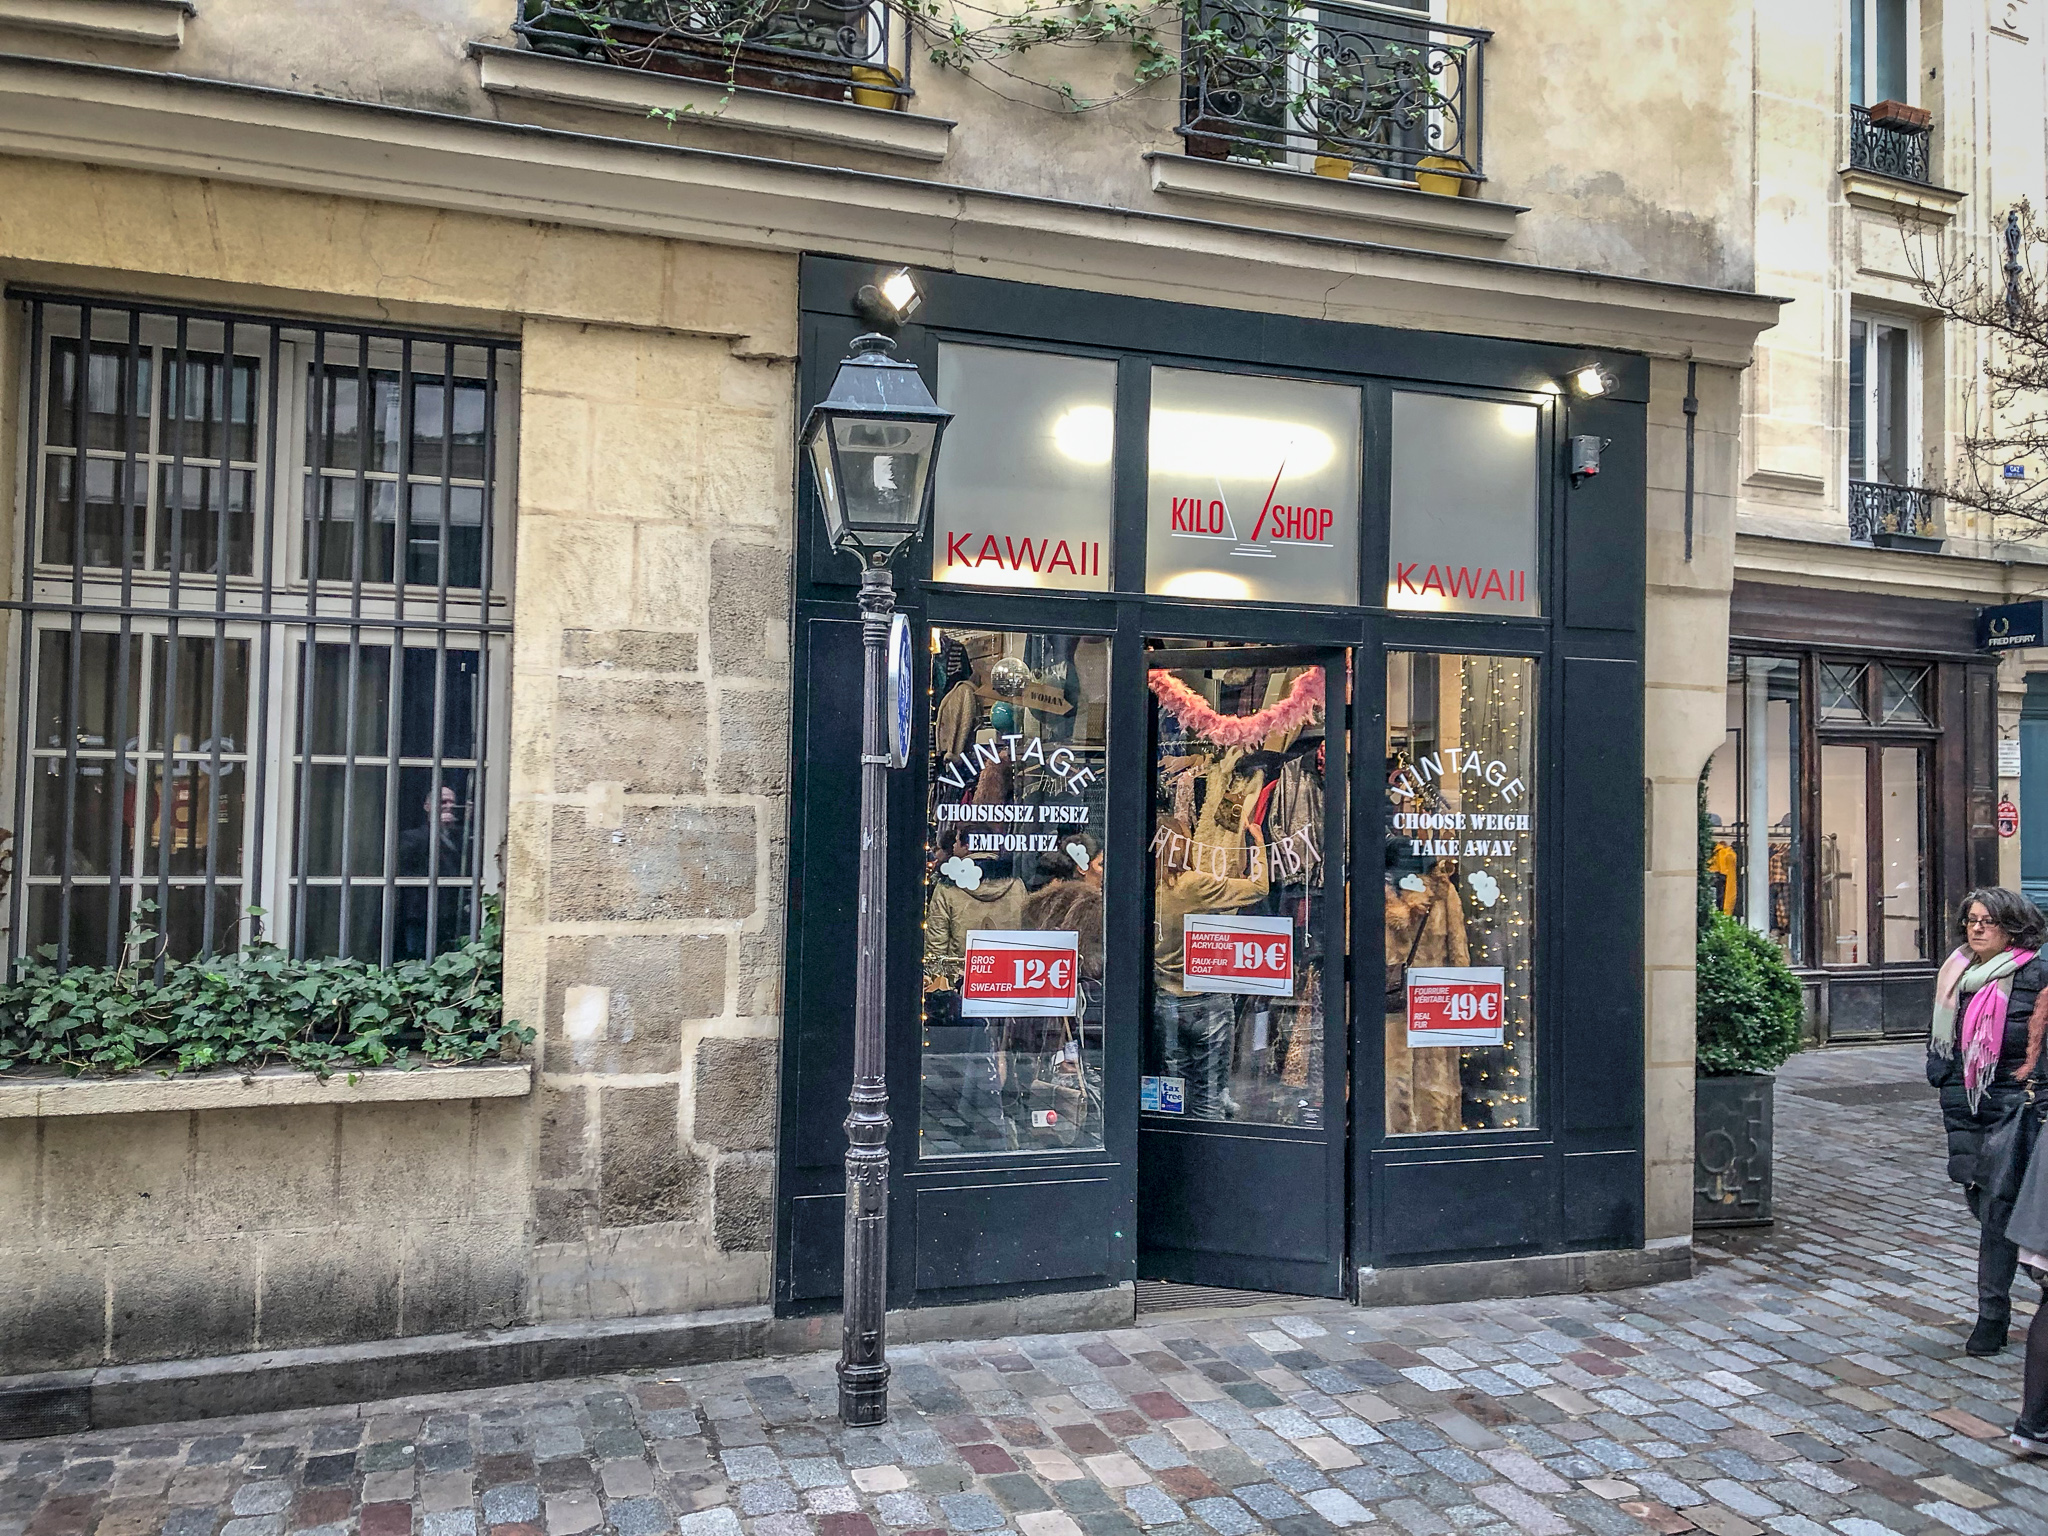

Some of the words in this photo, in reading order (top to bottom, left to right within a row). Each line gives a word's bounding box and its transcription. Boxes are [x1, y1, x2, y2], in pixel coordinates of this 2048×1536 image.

[1171, 497, 1225, 535] KILO
[1271, 505, 1334, 541] SHOP
[947, 531, 1100, 577] KAWAII
[1396, 562, 1526, 603] KAWAII
[1988, 637, 2009, 647] FRED
[2009, 634, 2036, 645] PERRY
[1031, 691, 1063, 707] WOMAN
[937, 733, 1098, 796] VINTAGE
[1391, 747, 1526, 805] VINTAGE
[936, 803, 1034, 824] CHOISISSEZ
[1038, 804, 1089, 824] PESEZ
[1392, 812, 1467, 832] CHOOSE
[1471, 813, 1530, 831] WEIGH
[968, 833, 1058, 853] EMPORTEZ
[1410, 839, 1460, 857] TAKE
[1463, 840, 1514, 857] AWAY
[1148, 824, 1228, 882] HELLO
[1248, 823, 1322, 884] BABY
[1191, 933, 1230, 942] MANTEAU
[1191, 941, 1234, 950] ACRYLIQUE
[970, 955, 996, 965] GROS
[1191, 957, 1228, 966] FAUX-FUR
[1233, 941, 1287, 971] 19€
[970, 964, 993, 974] PULL
[1012, 958, 1071, 990] 12€
[1191, 965, 1213, 974] COAT
[969, 982, 1013, 992] SWEATER
[1413, 986, 1451, 995] FOURRURE
[1413, 995, 1451, 1004] VÉRITABLE
[1442, 992, 1499, 1021] 49€
[1413, 1012, 1432, 1020] REAL
[1413, 1020, 1428, 1029] FUR
[1162, 1082, 1180, 1092] tax
[1163, 1091, 1183, 1101] free
